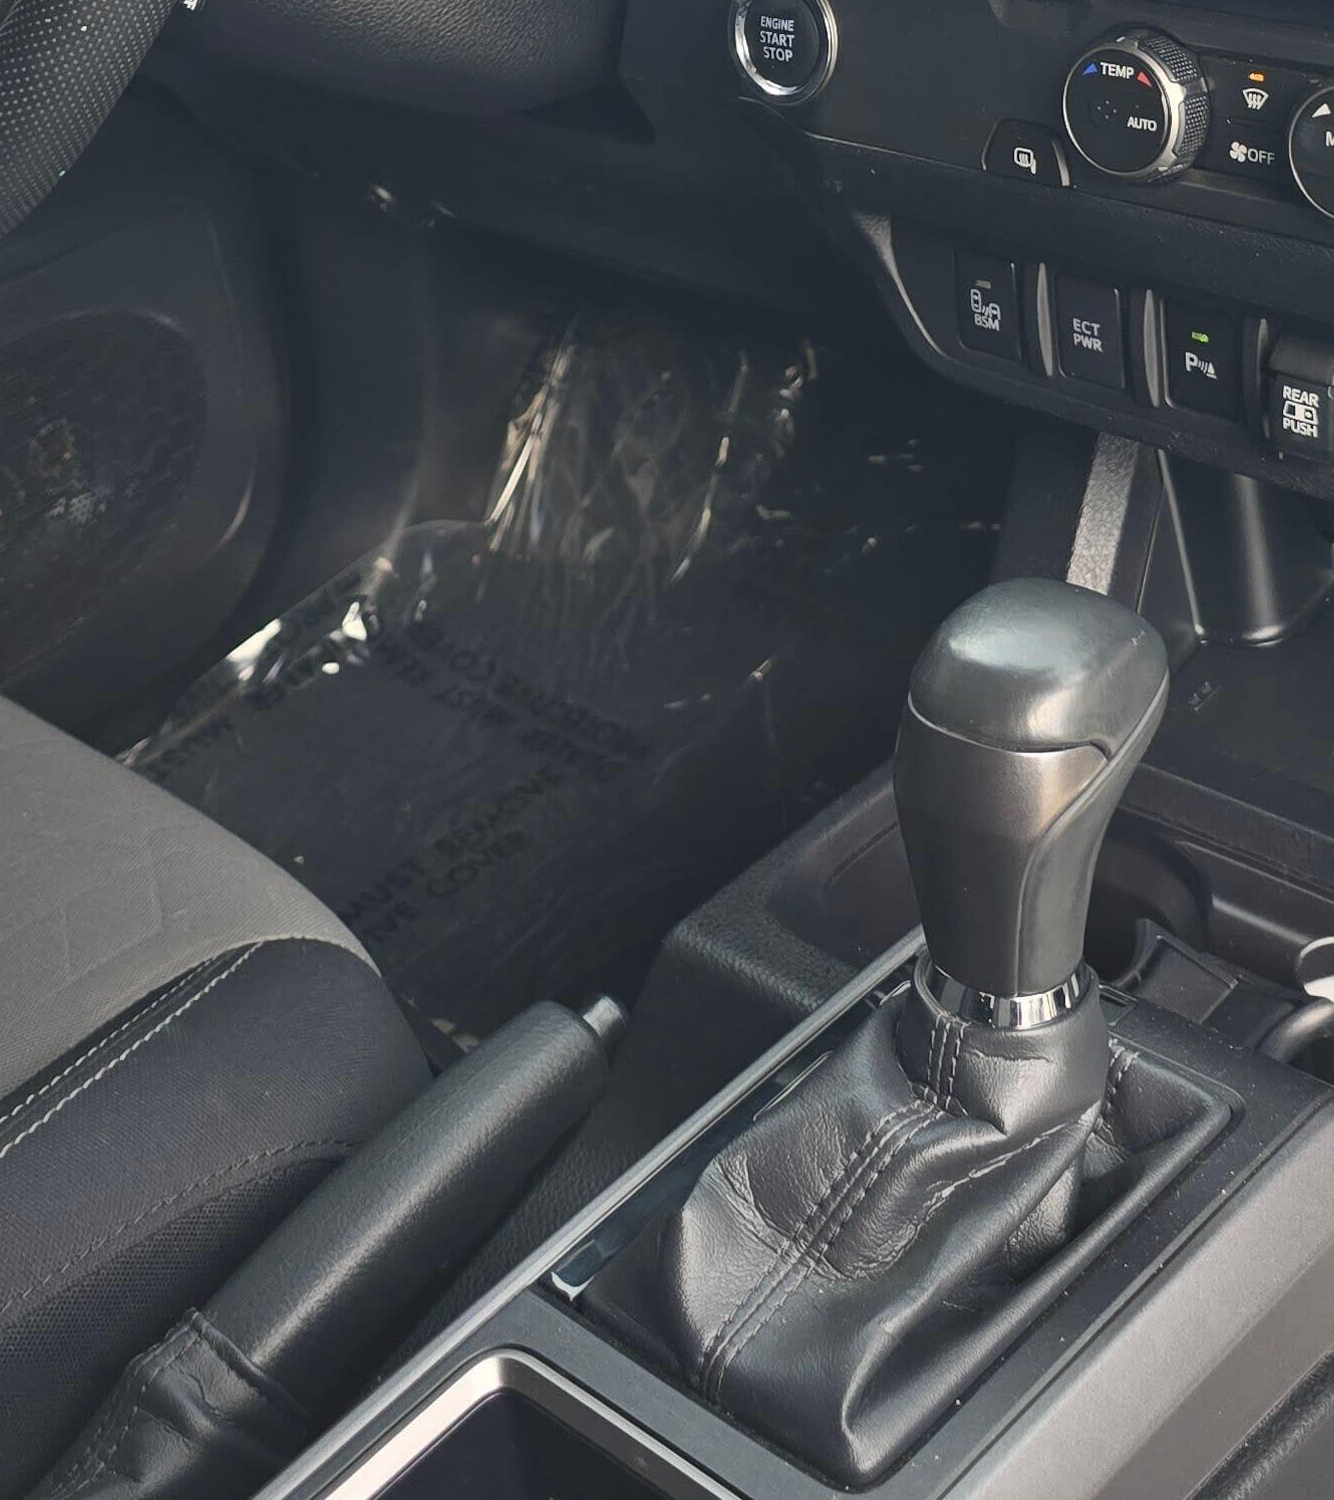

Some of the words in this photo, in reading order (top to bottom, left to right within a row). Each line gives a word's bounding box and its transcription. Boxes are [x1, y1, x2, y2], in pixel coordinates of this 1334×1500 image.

[760, 15, 795, 32] ENGINE
[760, 30, 795, 48] START
[763, 46, 793, 62] STOP
[1100, 61, 1135, 79] TEMP
[1127, 115, 1158, 132] AUTO
[1247, 149, 1276, 165] OFF
[974, 314, 1000, 332] BSM
[1073, 317, 1100, 336] ECT
[1073, 333, 1103, 352] PWR
[1283, 384, 1319, 408] REAR
[1283, 417, 1318, 438] PUSH
